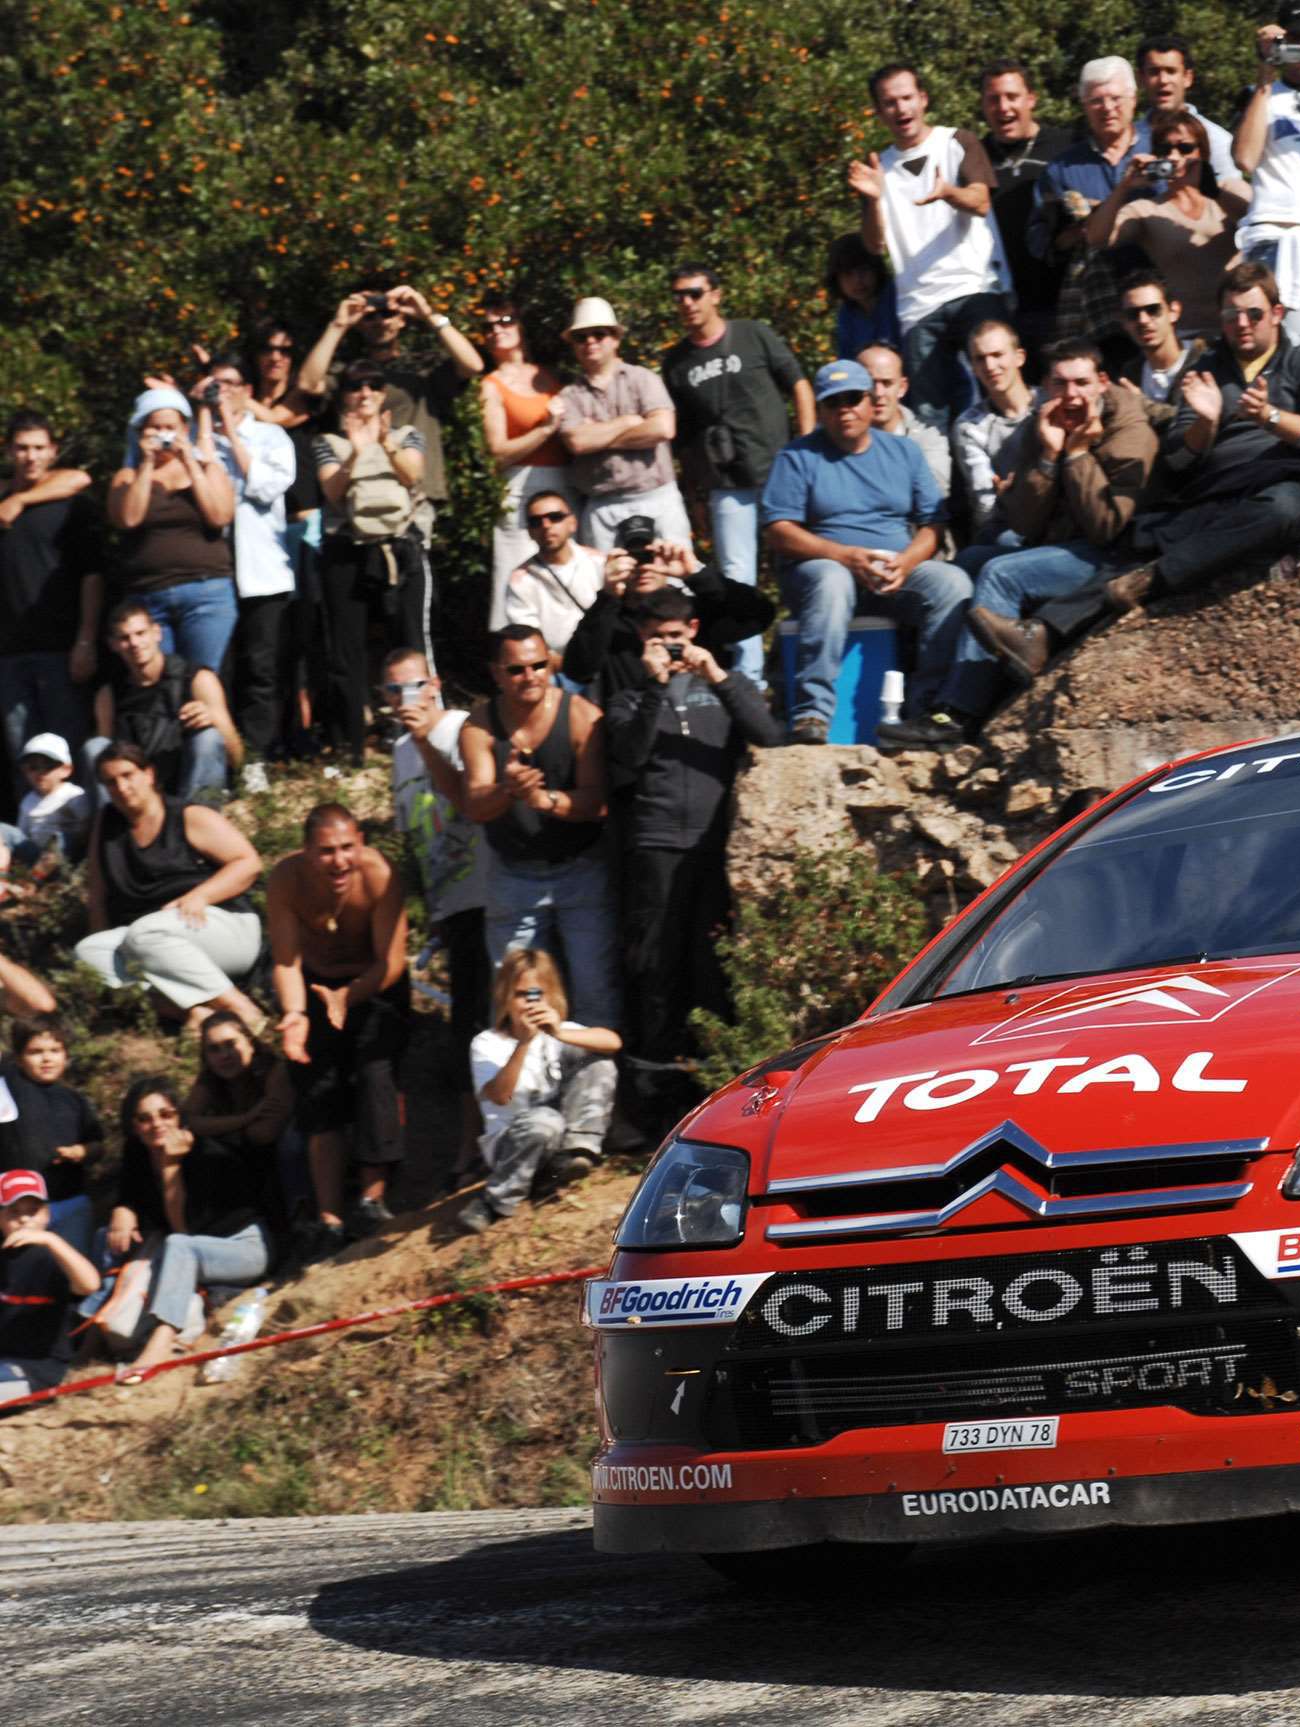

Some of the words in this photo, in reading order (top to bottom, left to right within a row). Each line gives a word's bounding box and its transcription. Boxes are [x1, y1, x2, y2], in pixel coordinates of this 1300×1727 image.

[848, 1052, 1248, 1123] TOTAL
[601, 1280, 742, 1314] BFGoodrich
[760, 1246, 1238, 1336] CITROËN
[1065, 1353, 1248, 1397] SPORT
[950, 1428, 981, 1447] 733
[987, 1425, 1024, 1444] DYN
[1031, 1424, 1051, 1441] 78
[902, 1482, 1110, 1516] EURODATACAR
